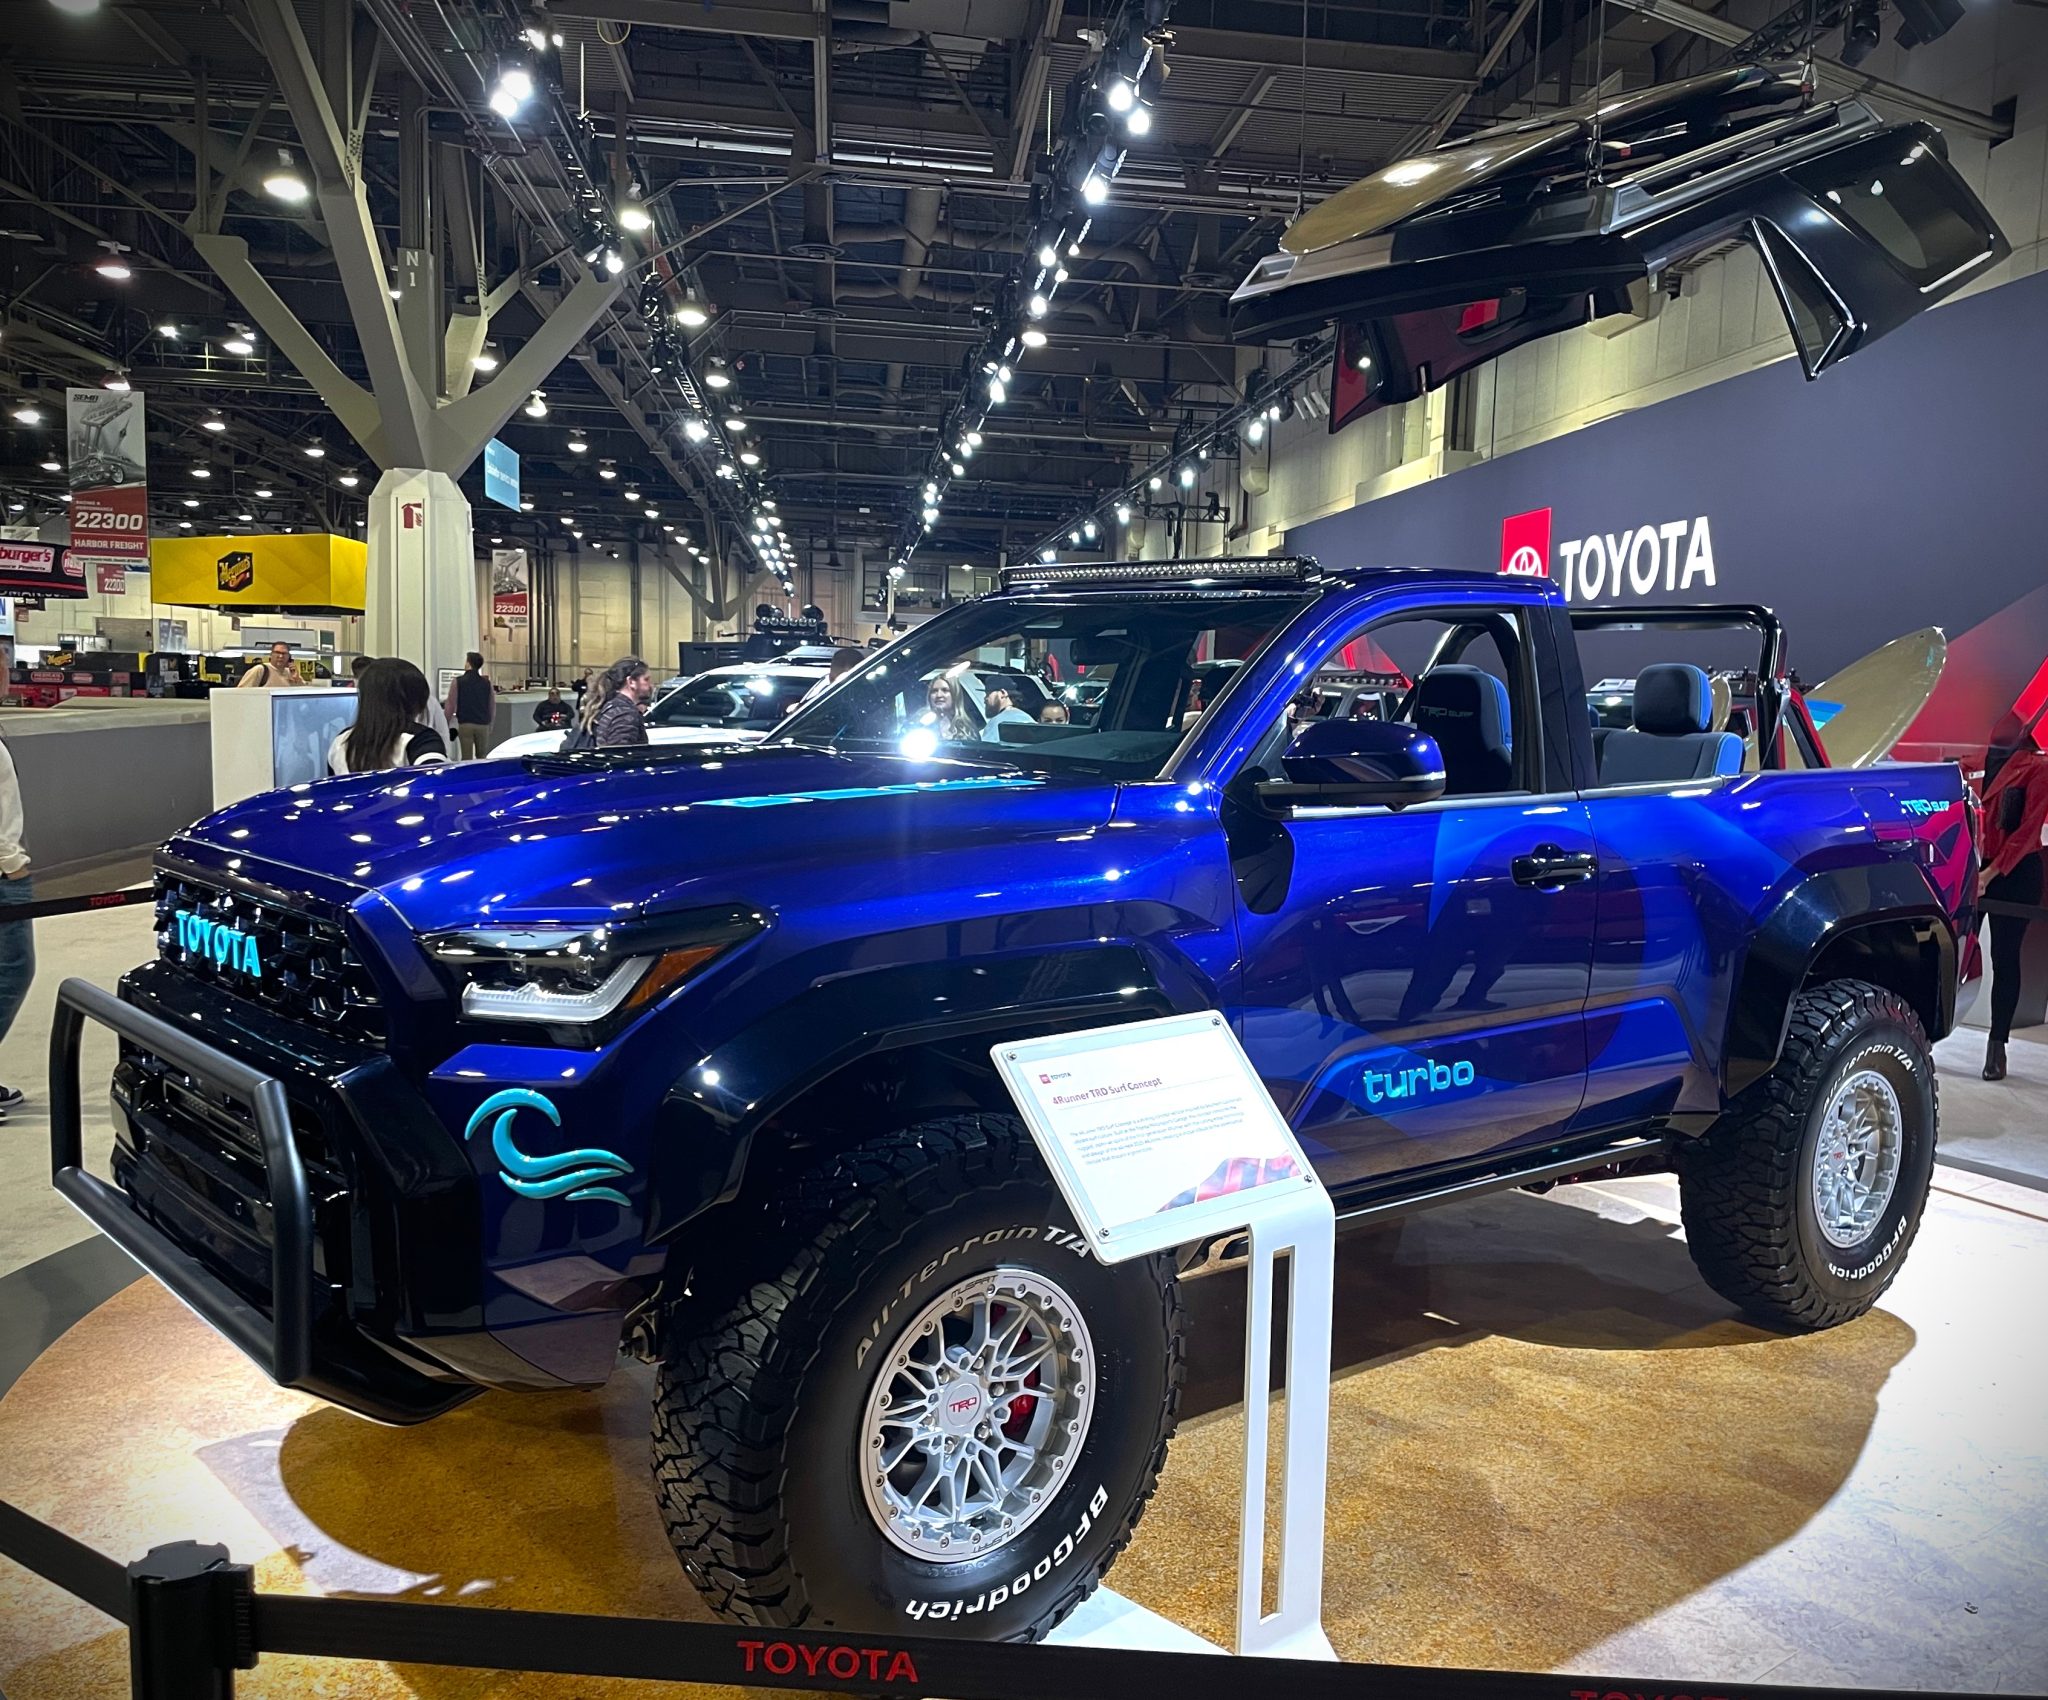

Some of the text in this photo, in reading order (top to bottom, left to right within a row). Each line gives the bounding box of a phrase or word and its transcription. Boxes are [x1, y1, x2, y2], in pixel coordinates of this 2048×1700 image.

[406, 251, 419, 267] N
[409, 272, 416, 287] 1
[74, 511, 144, 531] 22300
[74, 539, 144, 550] HARBOR FREIGHT
[1559, 516, 1717, 602] TOYOTA
[495, 604, 526, 613] 22300
[1900, 799, 1933, 816] TRD
[90, 893, 126, 906] TOYOTA
[175, 910, 262, 977] TOYOTA
[1893, 1046, 1917, 1072] T/A
[1050, 1072, 1072, 1081] TOYOTA
[1363, 1059, 1475, 1103] turbo
[1052, 1077, 1163, 1105] 4Runner TRD Surf Concept
[1828, 1215, 1907, 1280] BFGoodrich
[856, 1224, 1091, 1370] All-Terrain T/A
[949, 1397, 977, 1413] TRD
[905, 1484, 1109, 1621] BFGoodrich
[736, 1640, 919, 1683] TOYOTA
